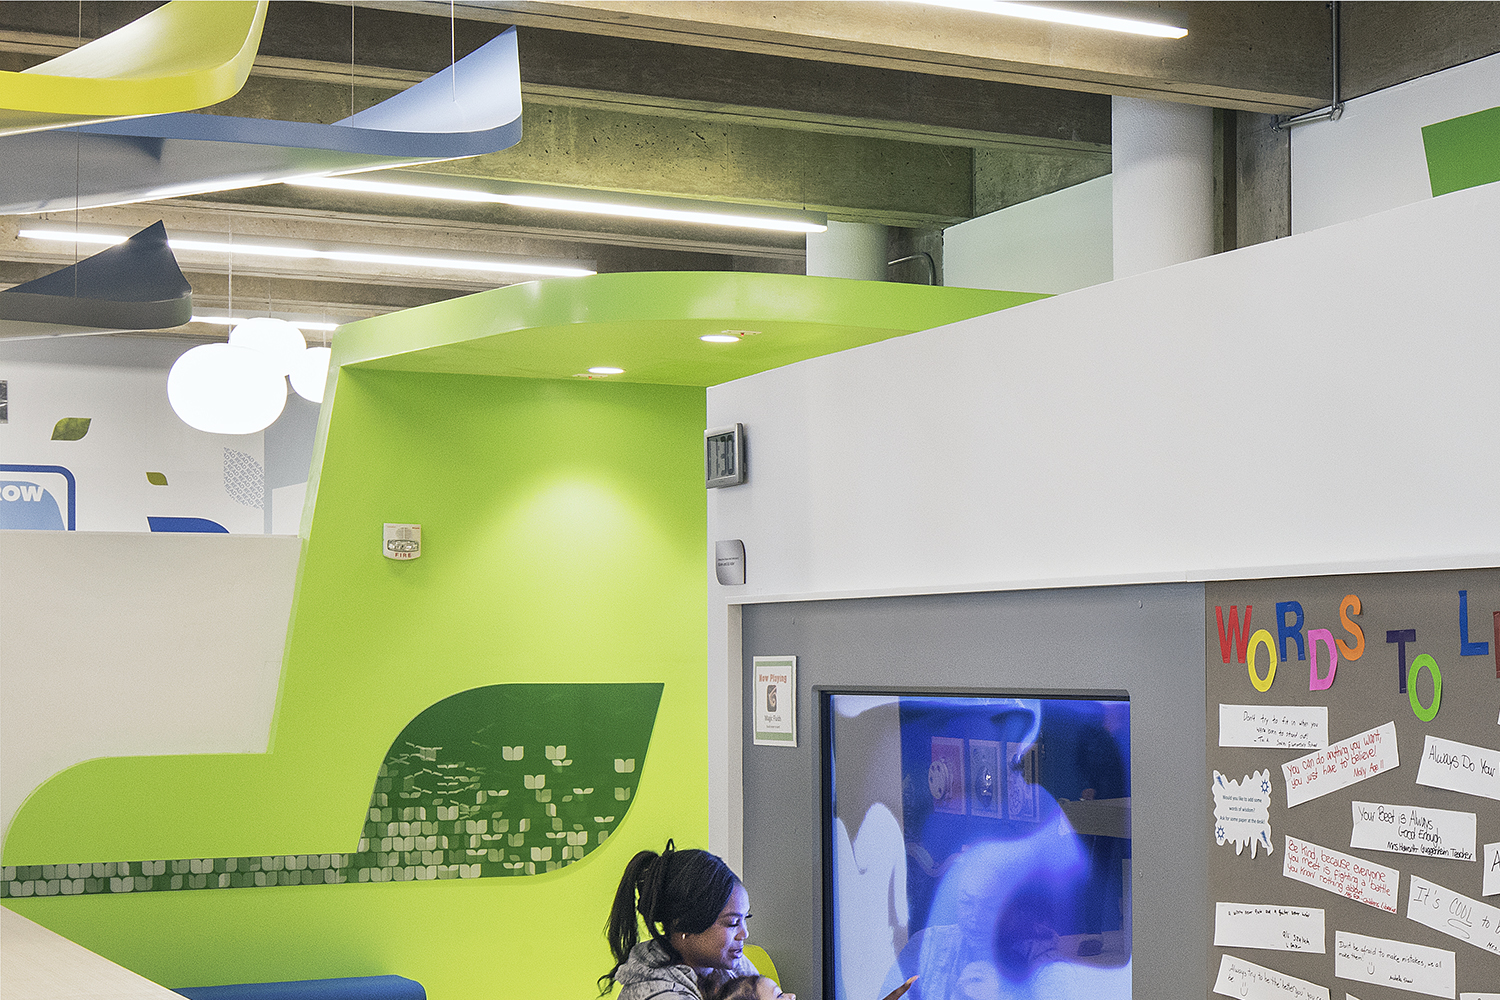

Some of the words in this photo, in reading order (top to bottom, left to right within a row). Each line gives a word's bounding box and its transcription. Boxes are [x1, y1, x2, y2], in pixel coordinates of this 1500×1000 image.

[0, 485, 43, 502] OW
[1215, 594, 1365, 692] WORDS
[1386, 629, 1442, 722] TO
[770, 674, 787, 684] Playing
[1287, 763, 1300, 777] You
[1302, 758, 1314, 770] can
[1316, 753, 1325, 766] do
[1327, 746, 1349, 762] anything
[1350, 740, 1360, 754] you
[1291, 778, 1302, 790] you
[1306, 768, 1318, 784] just
[1322, 764, 1336, 775] have
[1340, 758, 1348, 770] to
[1428, 745, 1459, 770] Always
[1462, 754, 1476, 772] Do
[1480, 759, 1496, 778] Your
[1358, 806, 1375, 822] Your
[1377, 806, 1395, 824] Best
[1399, 812, 1406, 824] is
[1409, 810, 1433, 830] Always
[1398, 826, 1416, 840] Good
[1418, 828, 1442, 848] Enough
[1288, 840, 1298, 853] Be
[1321, 850, 1350, 870] because
[1353, 864, 1386, 882] everyone
[1288, 853, 1299, 863] you
[1302, 856, 1320, 870] meet
[1323, 865, 1331, 875] is
[1334, 870, 1358, 888] fighting
[1370, 880, 1391, 896] battle
[1288, 863, 1298, 873] you
[1320, 874, 1344, 893] nothing
[1414, 886, 1440, 910] It's
[1481, 916, 1490, 928] to
